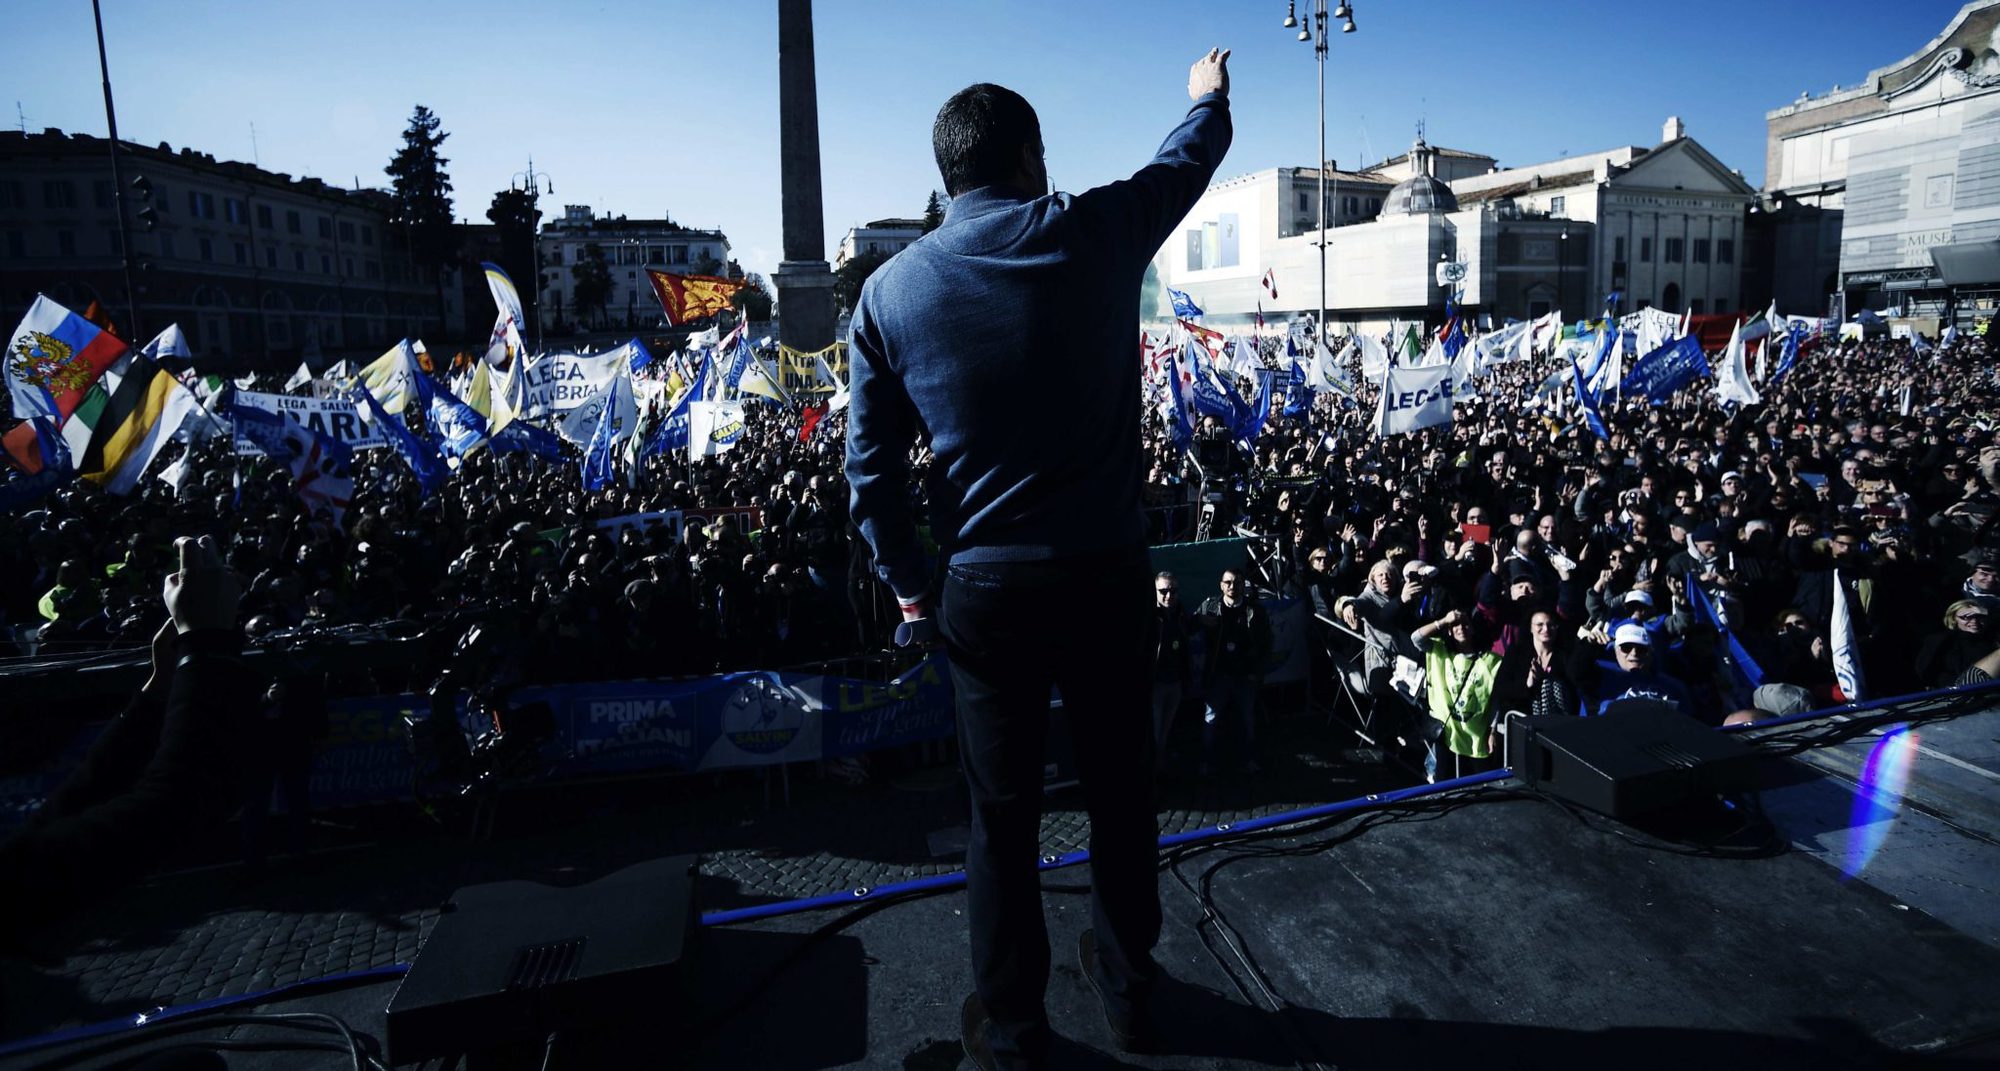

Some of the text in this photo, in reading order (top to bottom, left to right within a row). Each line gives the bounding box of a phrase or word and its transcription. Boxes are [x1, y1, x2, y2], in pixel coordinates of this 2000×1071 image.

[525, 361, 586, 387] LEGA
[785, 372, 814, 389] UNA
[277, 398, 357, 411] LEGA SALVI
[527, 383, 599, 407] ALBRIA
[839, 664, 942, 713] LEGA
[589, 699, 677, 724] PRIMA
[576, 727, 692, 757] ITALIANI
